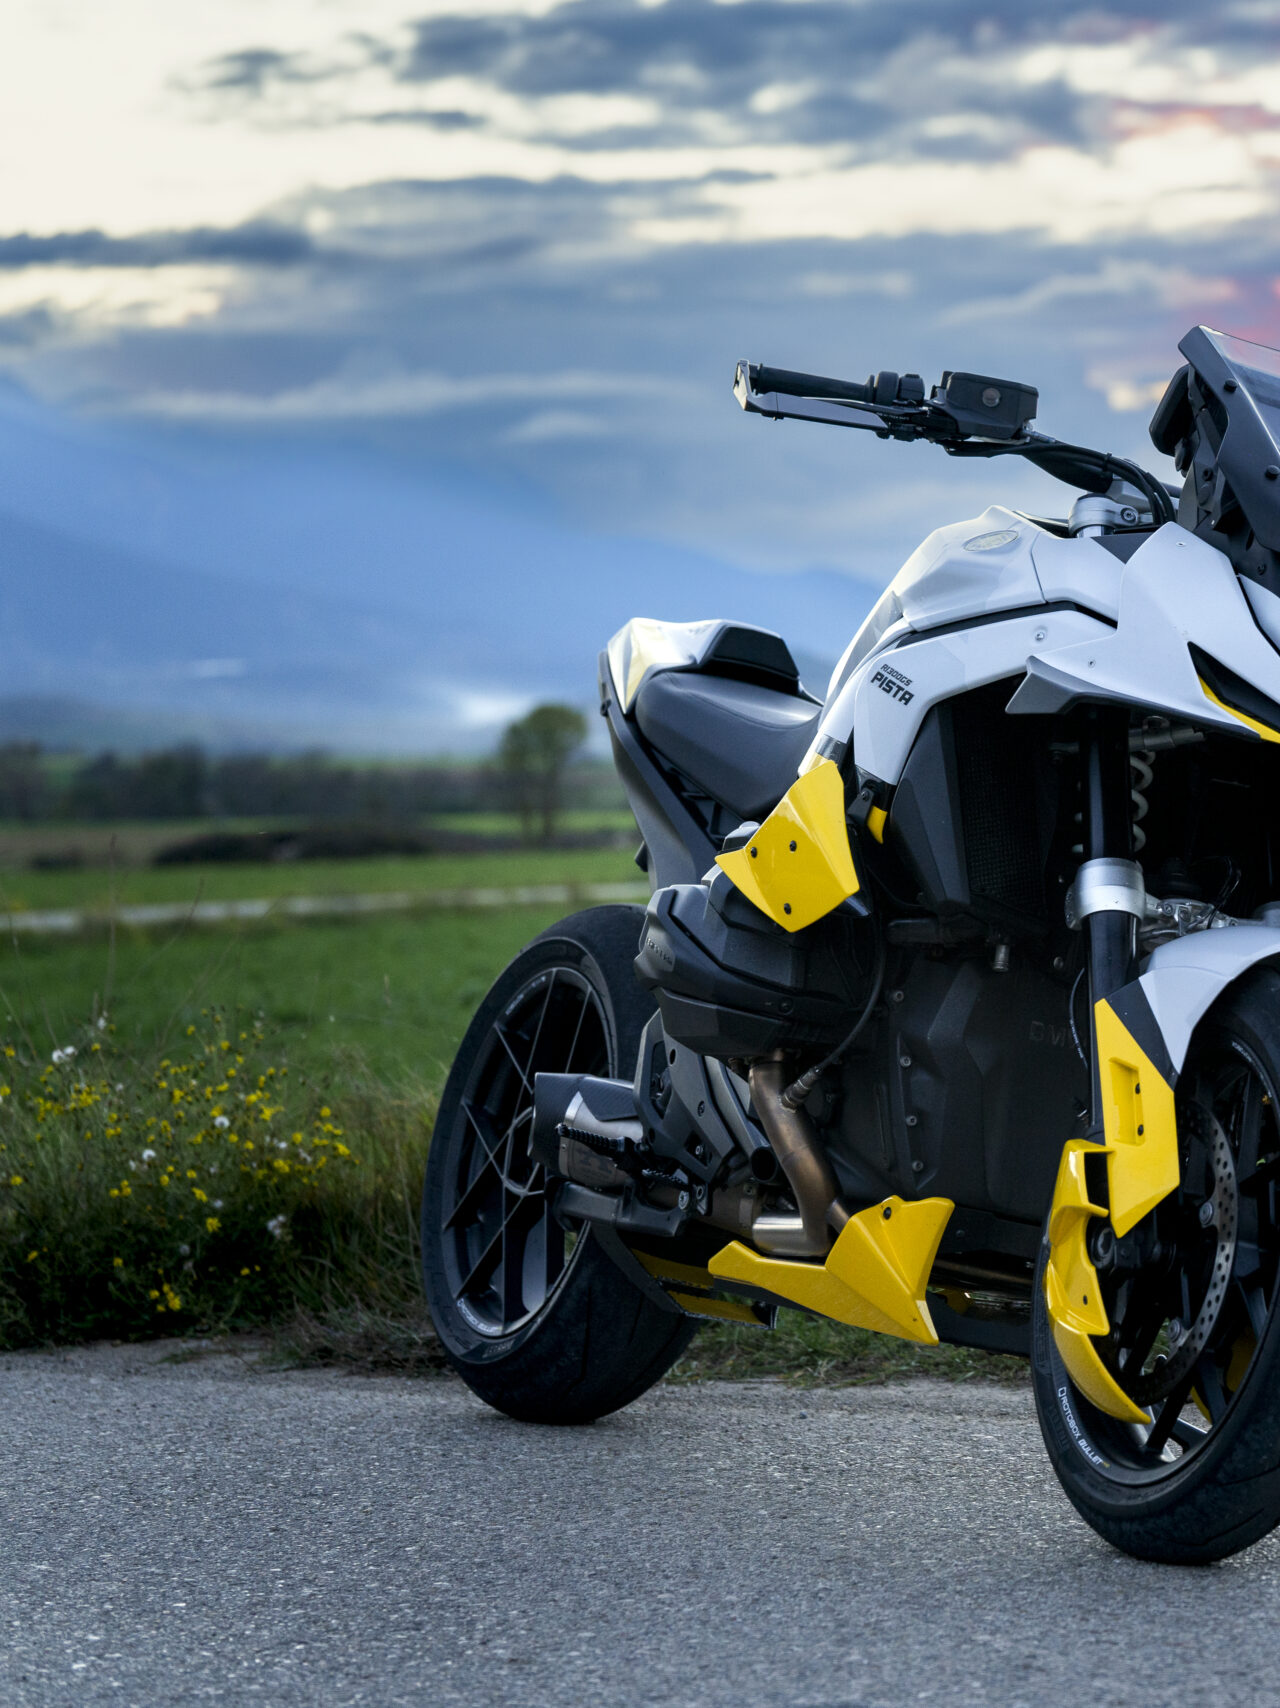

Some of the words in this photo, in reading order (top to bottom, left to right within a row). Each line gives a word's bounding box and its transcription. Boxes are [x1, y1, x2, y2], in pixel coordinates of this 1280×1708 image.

[870, 671, 915, 706] PISTA
[1061, 1395, 1082, 1439] ROTOBOX
[1078, 1438, 1105, 1465] BULLET
